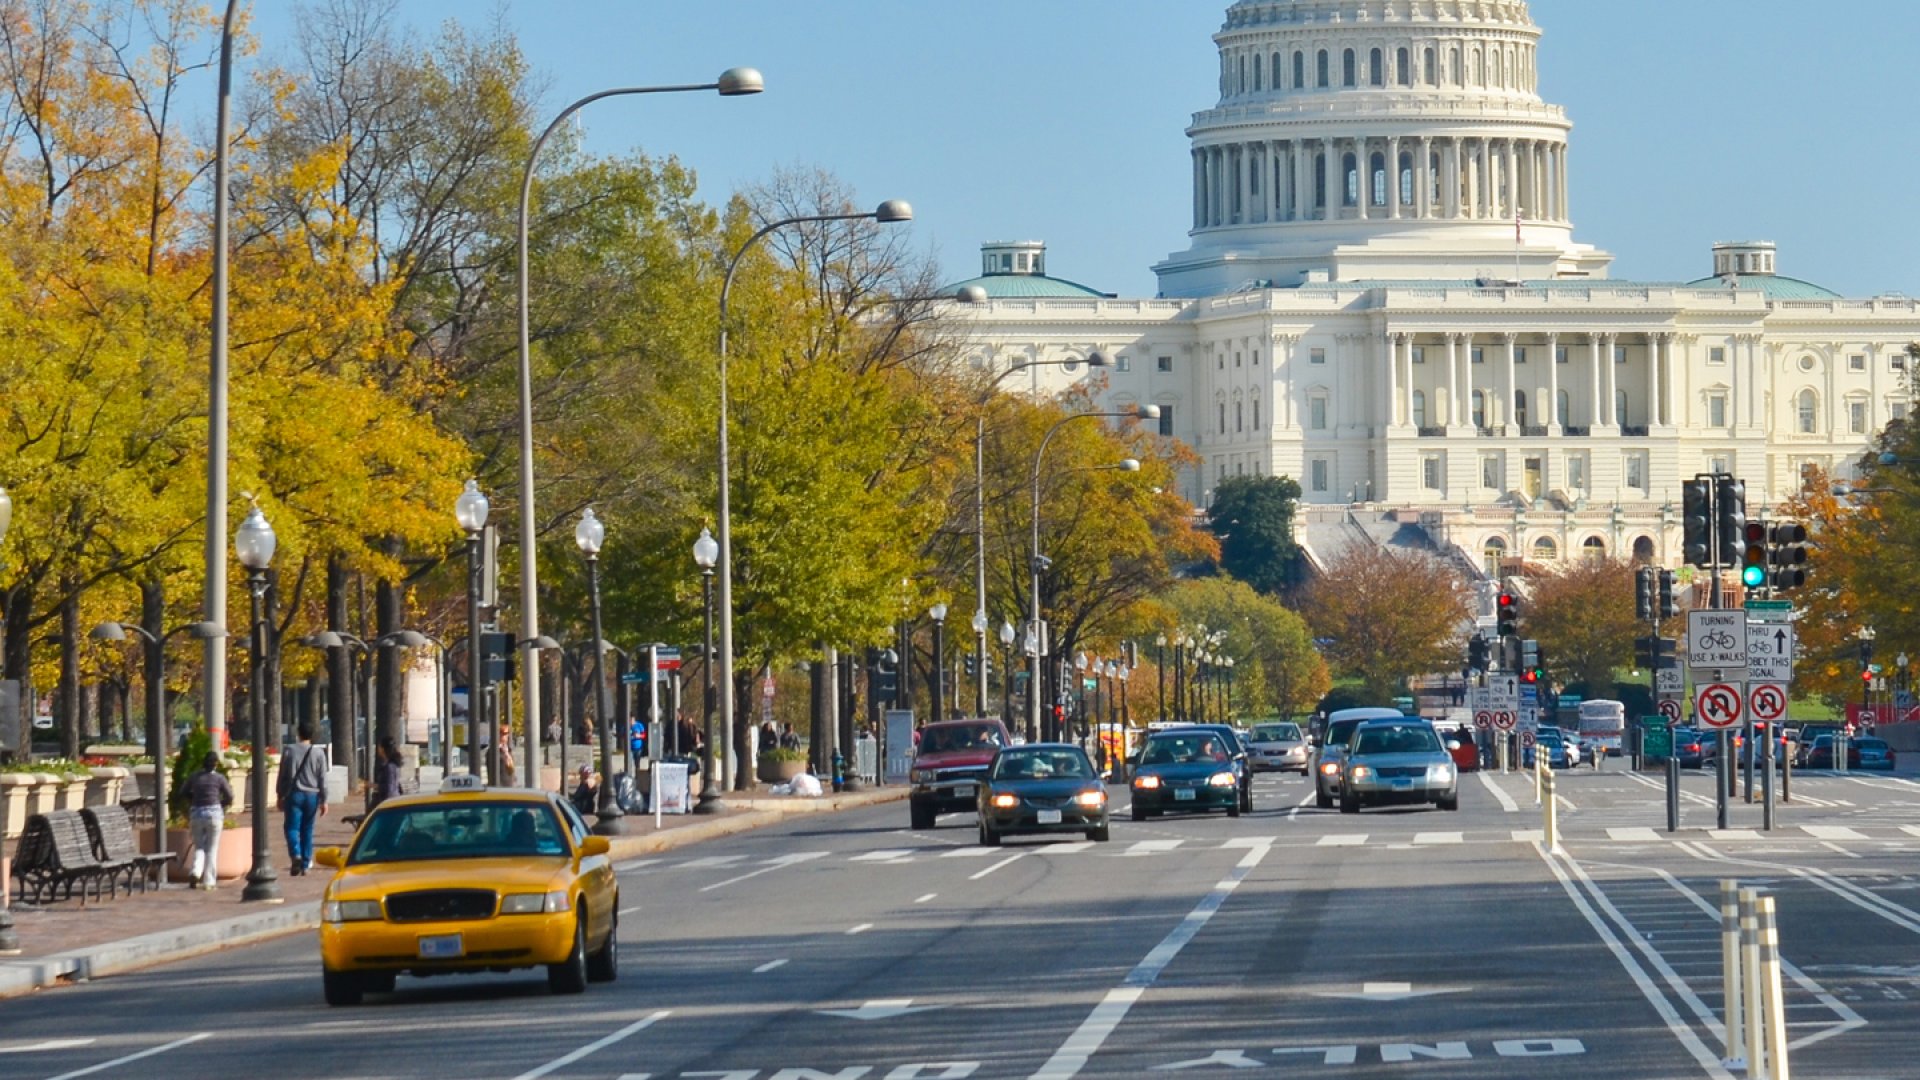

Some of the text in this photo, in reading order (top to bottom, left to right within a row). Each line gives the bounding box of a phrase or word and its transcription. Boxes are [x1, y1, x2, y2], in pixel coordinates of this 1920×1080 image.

[1700, 616, 1735, 626] TURNING
[1748, 627, 1769, 637] THRU
[1690, 653, 1706, 662] USE
[1771, 657, 1789, 667] THIS
[1748, 668, 1776, 678] SIGNAL
[451, 778, 472, 788] TAXI
[1145, 1038, 1587, 1070] ONLY
